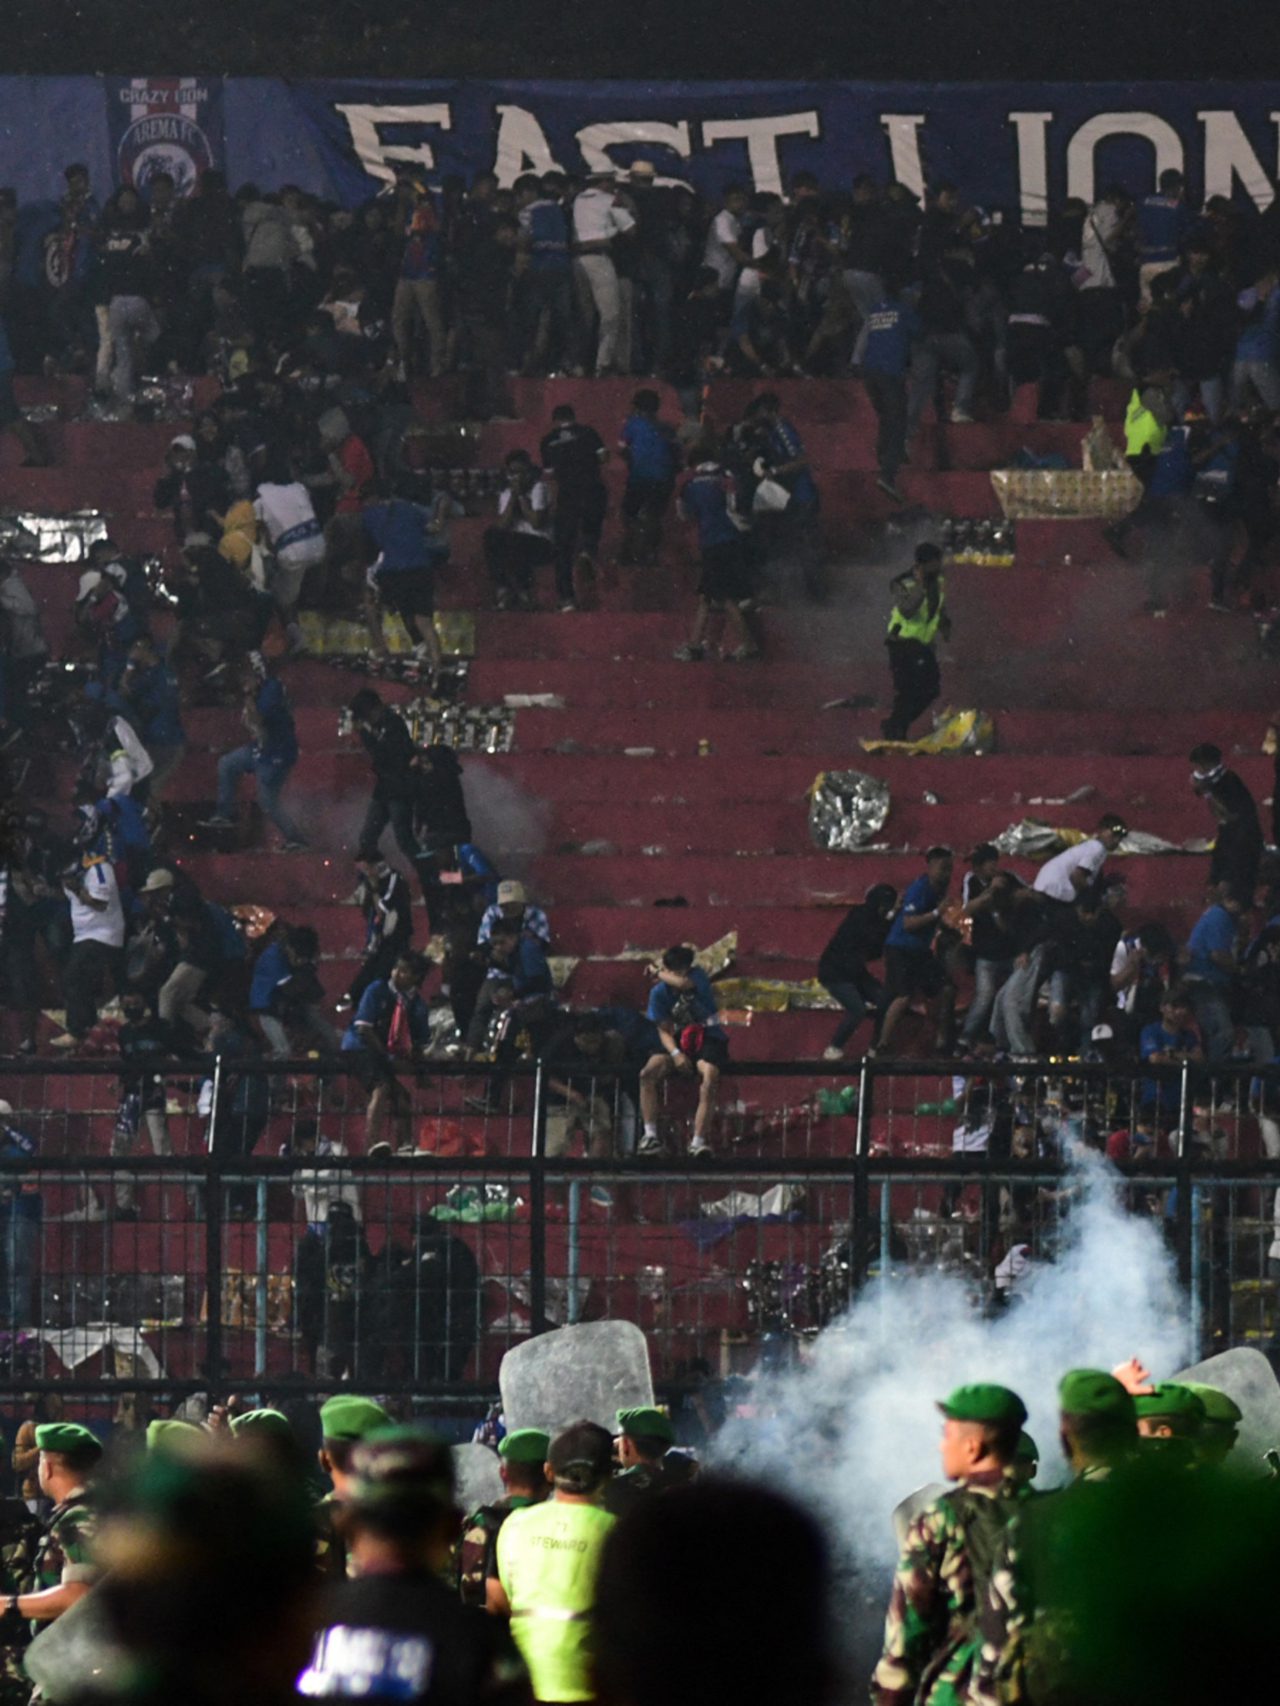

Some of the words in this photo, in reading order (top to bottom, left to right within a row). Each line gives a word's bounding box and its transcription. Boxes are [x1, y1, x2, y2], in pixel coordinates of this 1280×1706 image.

[119, 87, 169, 103] CRAZY
[335, 101, 820, 205] EAST
[530, 1535, 588, 1553] STEWARD
